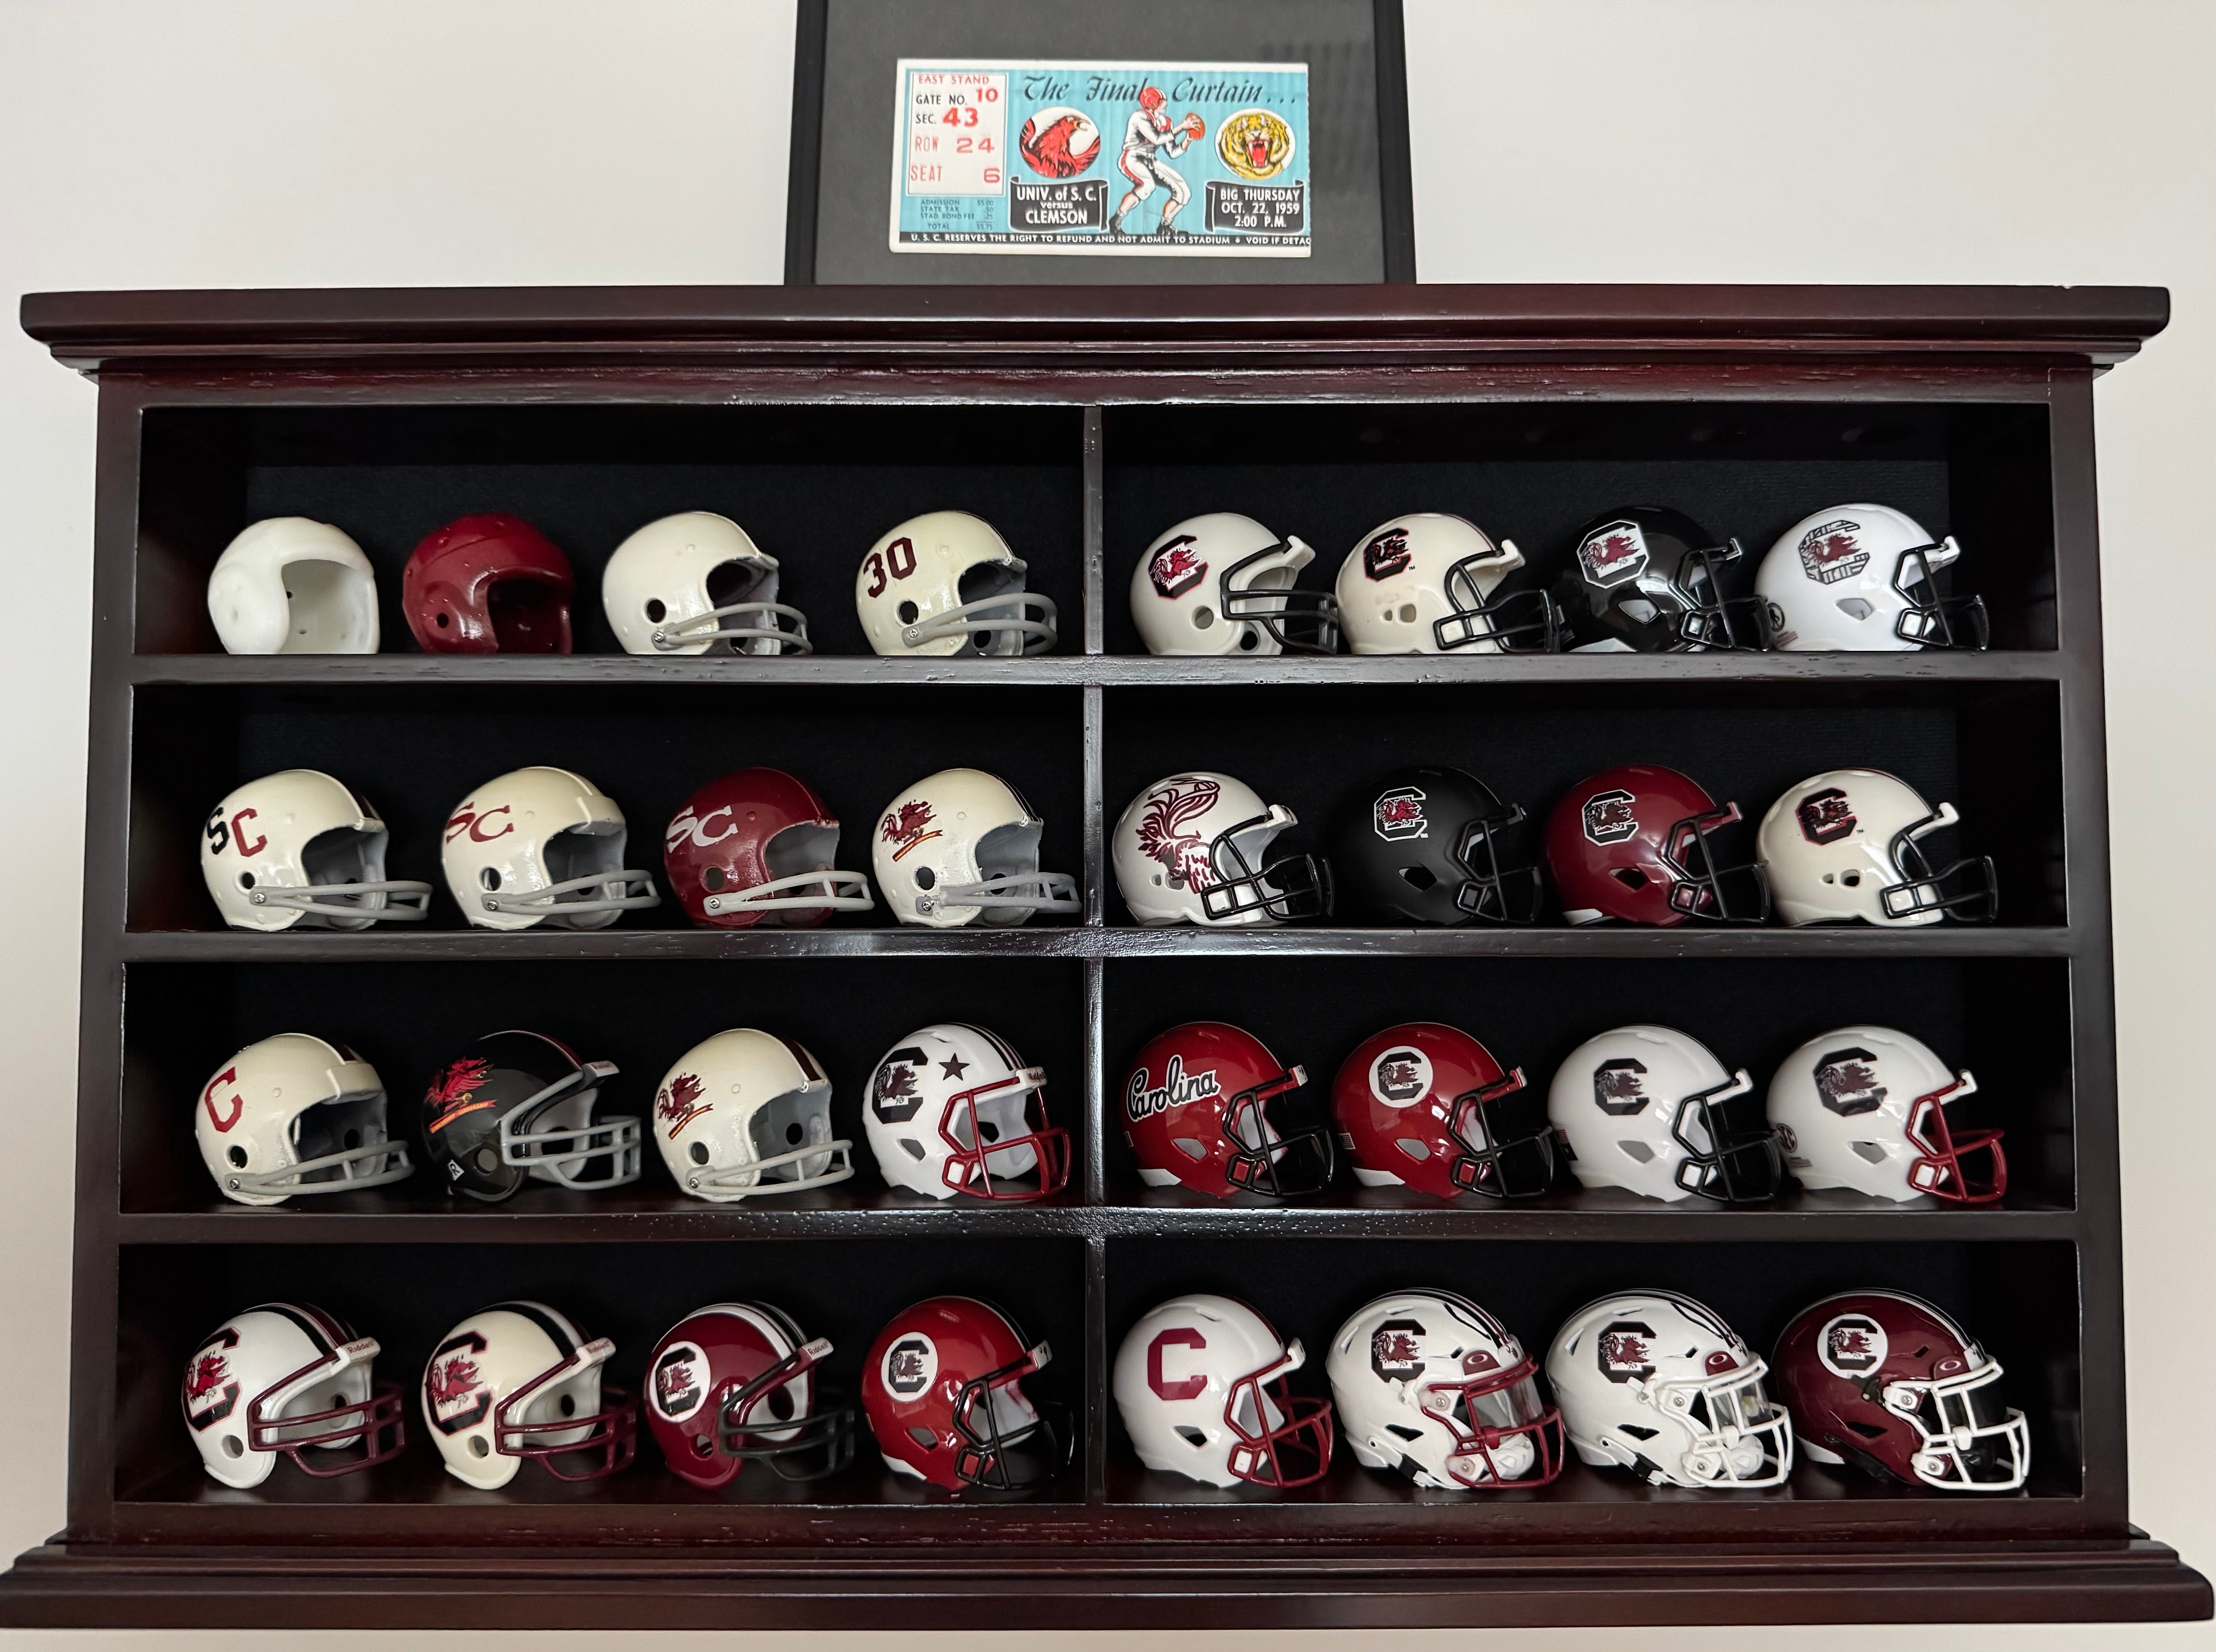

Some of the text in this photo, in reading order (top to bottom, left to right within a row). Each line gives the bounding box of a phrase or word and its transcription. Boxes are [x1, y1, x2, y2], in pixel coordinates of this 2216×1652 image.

[919, 76, 989, 85] EAST STAND
[1024, 76, 1069, 101] The
[1086, 76, 1148, 101] Final
[916, 88, 998, 105] GATE NO. 10
[916, 107, 978, 127] SEC. 43
[916, 136, 995, 153] ROW 24
[911, 165, 1000, 183] SEAT 6
[1017, 187, 1096, 201] UNIV. of S. C.
[1221, 189, 1300, 201] BIG THURSDAY
[1026, 210, 1087, 224] CLEMSON
[1221, 202, 1300, 215] OCT. 22, 1959
[1234, 215, 1287, 227] 2:00 P.M.
[863, 537, 917, 598] 30
[207, 807, 268, 857] SC
[446, 801, 514, 844] SC
[665, 805, 738, 853] SC
[1127, 1055, 1221, 1121] Carolina
[205, 1067, 243, 1133] C
[1147, 1327, 1207, 1400] C
